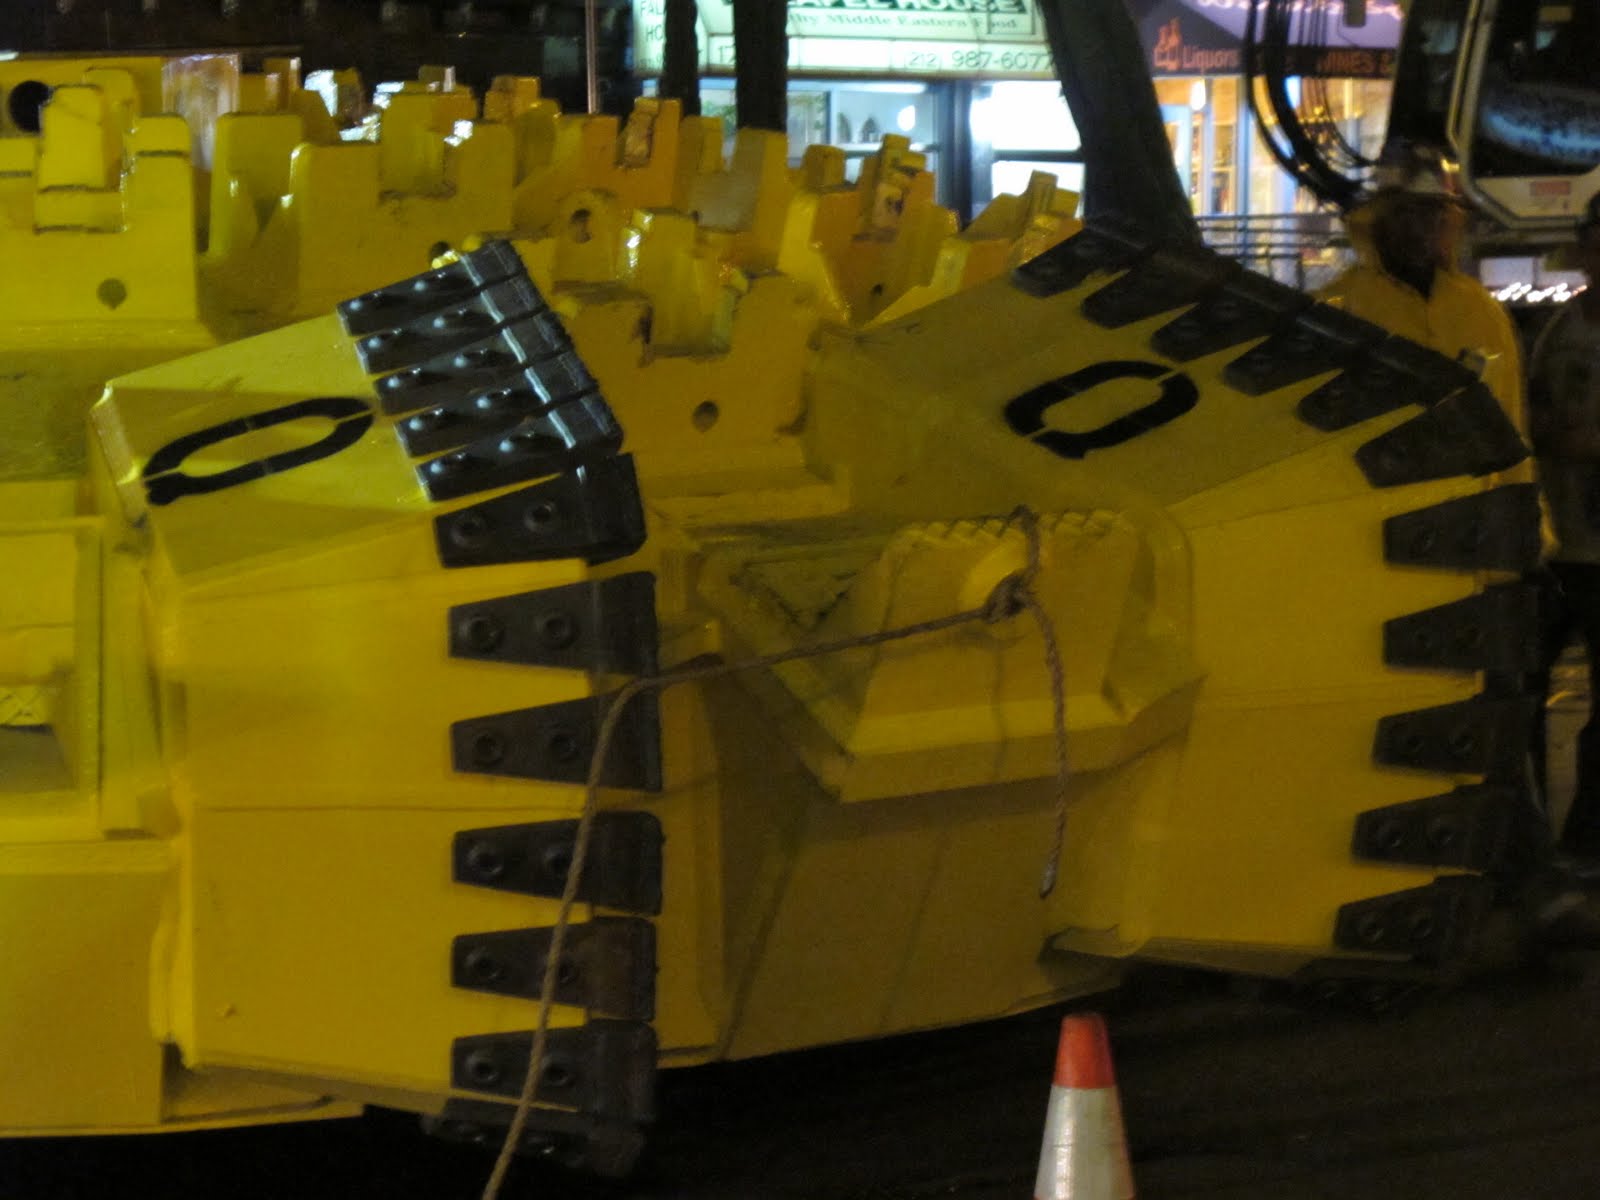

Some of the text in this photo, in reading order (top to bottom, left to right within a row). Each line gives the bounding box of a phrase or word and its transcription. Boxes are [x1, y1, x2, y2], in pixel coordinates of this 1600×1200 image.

[827, 14, 891, 25] Middle
[896, 15, 968, 27] Eastern
[951, 50, 1056, 71] 987-6077
